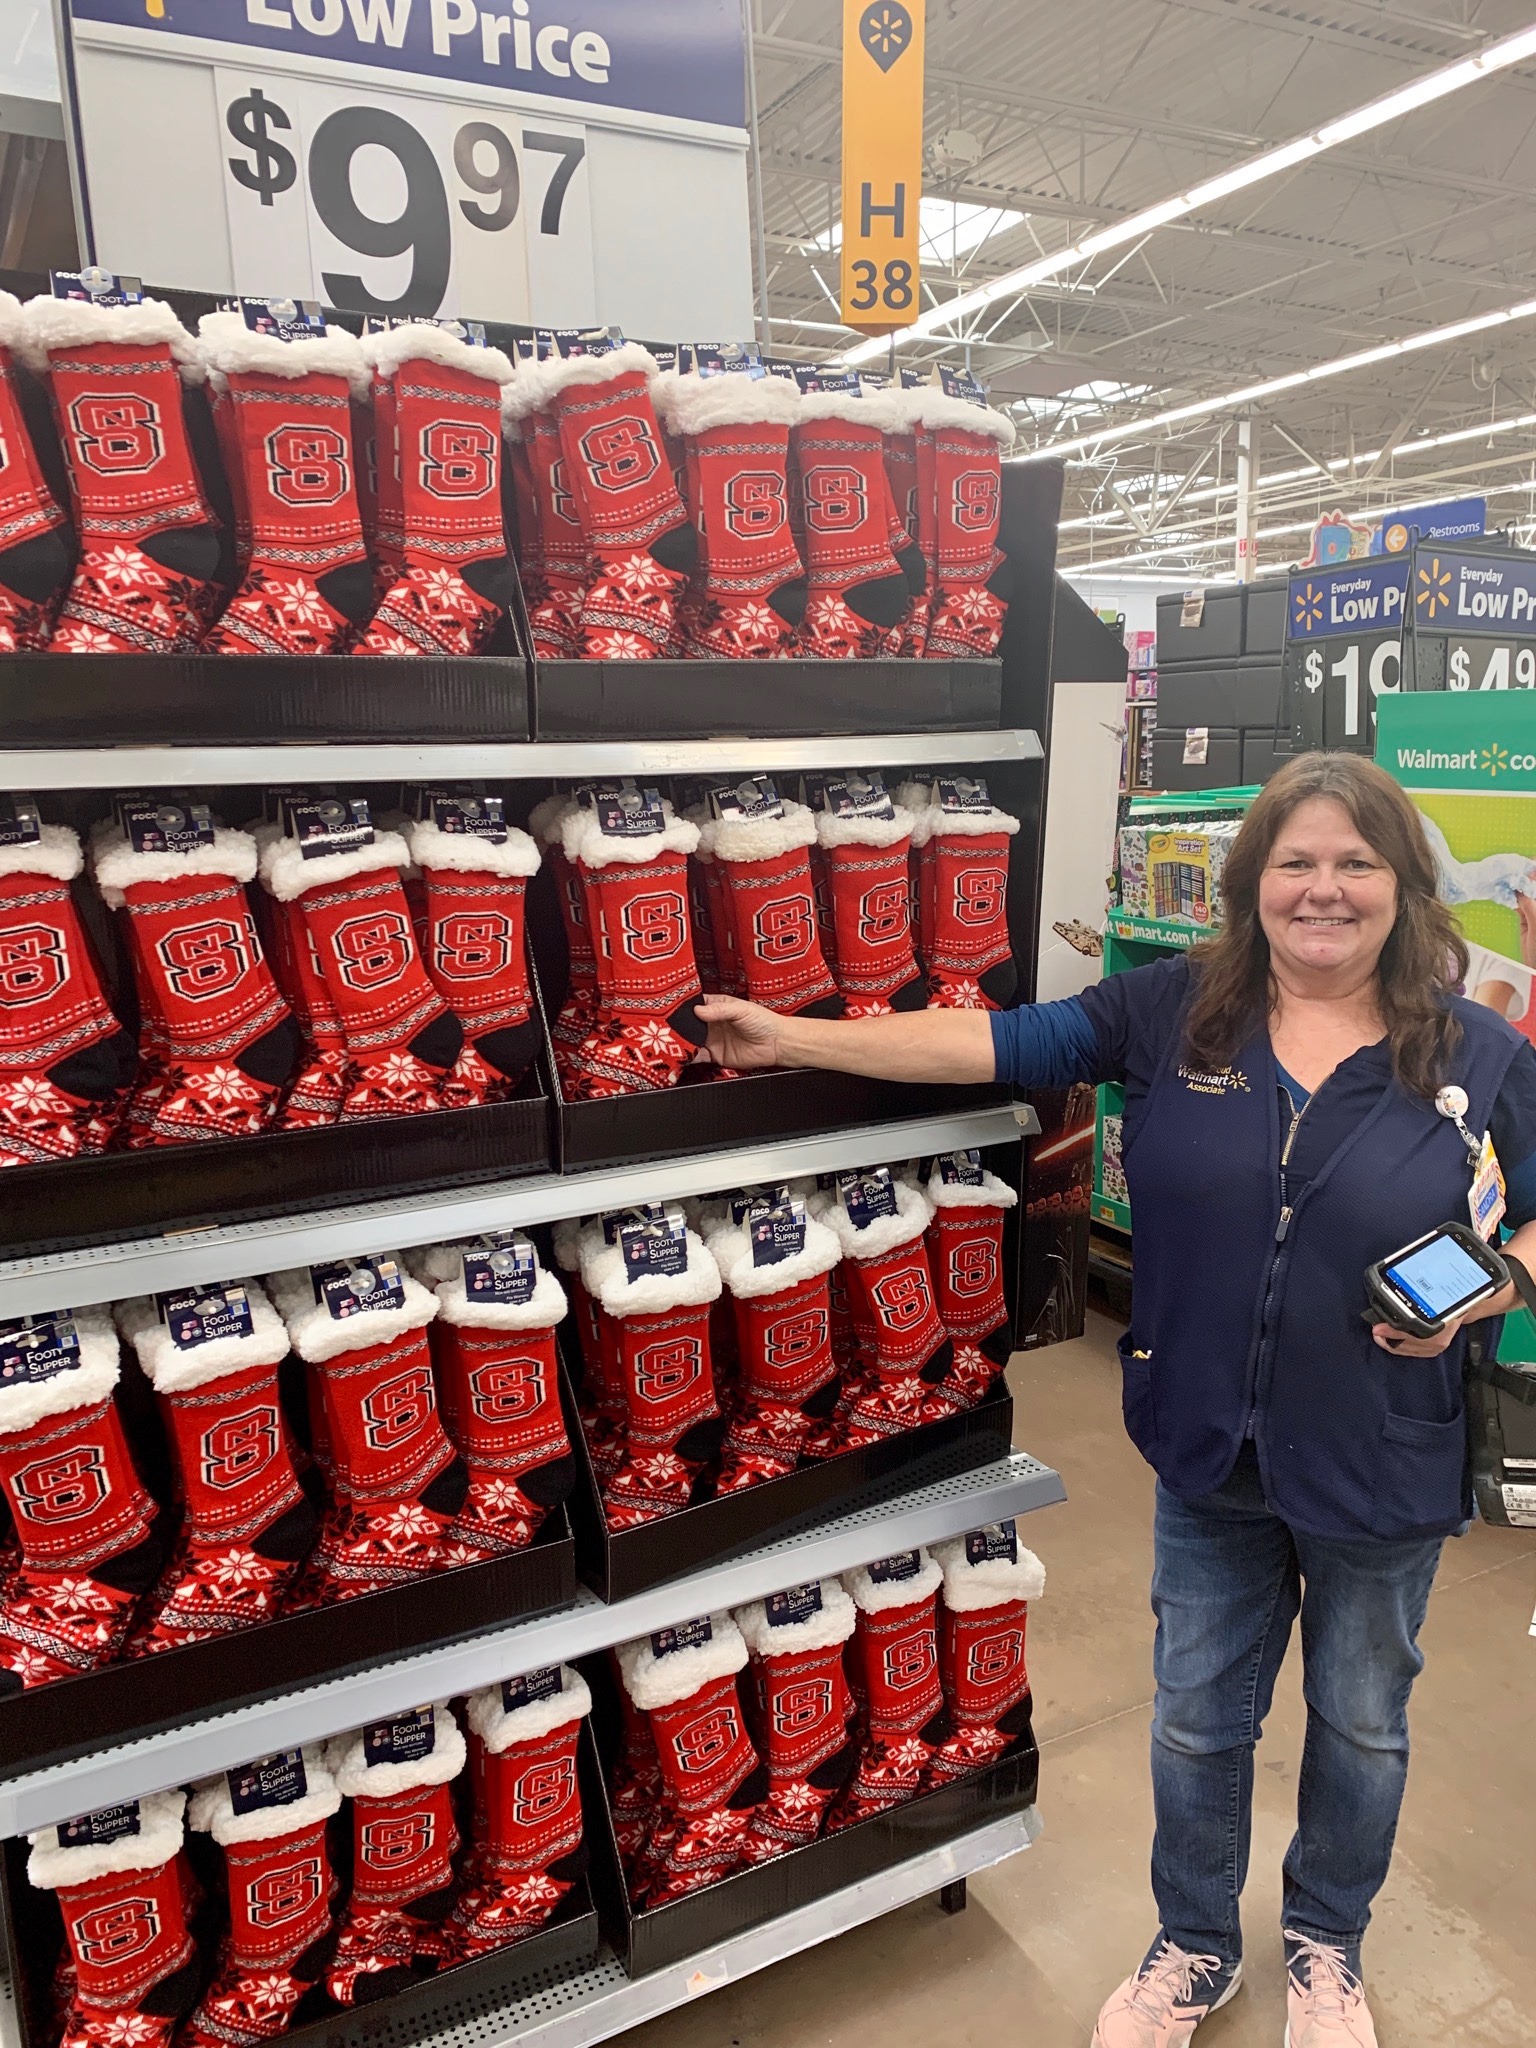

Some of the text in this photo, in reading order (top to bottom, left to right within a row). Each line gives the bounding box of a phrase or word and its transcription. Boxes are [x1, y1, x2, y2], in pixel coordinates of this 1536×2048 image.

[247, 0, 611, 84] Low Price
[860, 182, 905, 238] H
[850, 259, 913, 310] 38
[1430, 522, 1480, 539] Restrooms
[1461, 566, 1503, 586] Everyday
[1331, 578, 1372, 594] Everyday
[1457, 582, 1509, 619] Low
[1331, 596, 1379, 624] Low
[1397, 748, 1478, 770] Walmart
[464, 817, 493, 826] FOOTY
[625, 810, 651, 820] FOOTY
[328, 823, 359, 833] FOOTY
[626, 819, 657, 829] SLIPPER
[165, 830, 199, 841] FOOTY
[1194, 905, 1207, 914] 140
[1177, 1065, 1229, 1086] Walmart
[1186, 1081, 1226, 1095] Associate
[958, 1176, 980, 1186] SLIPPER
[865, 1190, 891, 1205] SLIPPER
[773, 1222, 797, 1234] FOOTY
[648, 1237, 675, 1250] FOOTY
[774, 1231, 801, 1243] SLIPPER
[649, 1245, 680, 1260] SLIPPER
[493, 1269, 523, 1281] FOOTY
[494, 1278, 528, 1291] SLIPPER
[358, 1289, 391, 1304] FOOTY
[202, 1314, 236, 1328] FOOTY
[205, 1321, 243, 1338] SLIPPER
[26, 1348, 63, 1364] FOOTY
[29, 1356, 71, 1375] SLIPPER
[986, 1544, 1012, 1555] SLIPPER
[788, 1594, 816, 1610] SLIPPER
[676, 1630, 705, 1646] SLIPPER
[525, 1667, 551, 1684] FOOTY
[526, 1674, 555, 1692] SLIPPER
[392, 1724, 422, 1737] FOOTY
[392, 1731, 427, 1746] SLIPPER
[259, 1764, 290, 1782] FOOTY
[261, 1770, 297, 1792] SLIPPER
[89, 1807, 123, 1824] FOOTY
[91, 1815, 131, 1834] SLIPPER
